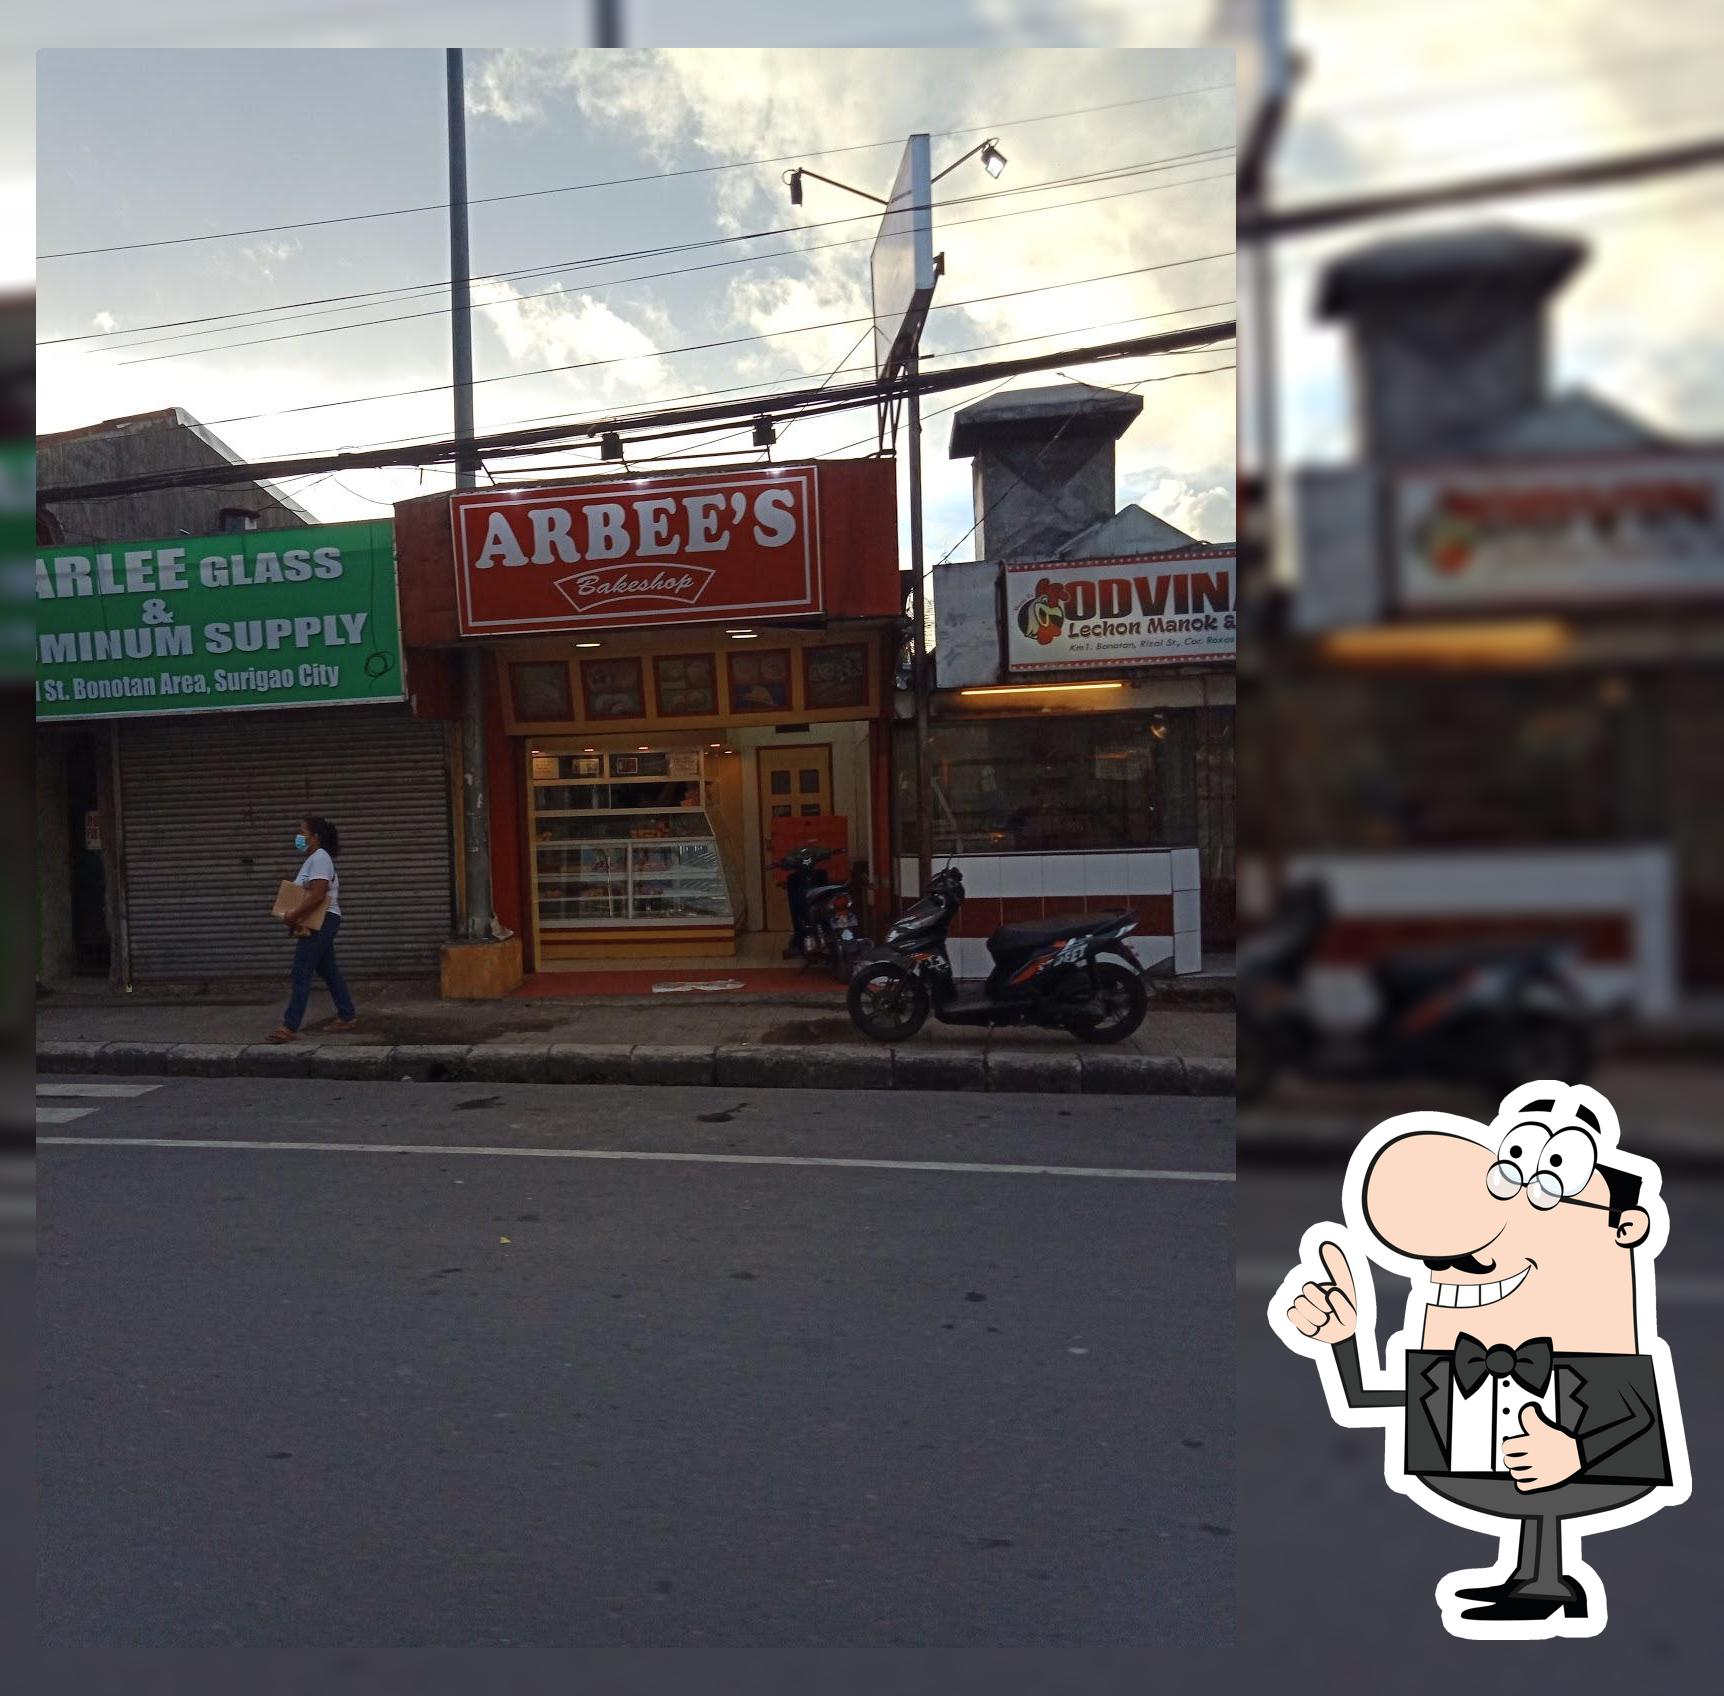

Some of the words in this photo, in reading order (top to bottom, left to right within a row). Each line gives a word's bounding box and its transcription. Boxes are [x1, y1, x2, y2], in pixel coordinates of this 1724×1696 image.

[475, 489, 797, 569] ARBEE'S
[199, 547, 343, 588] GLASS
[577, 572, 693, 597] Bakeshop
[142, 598, 174, 625] &
[1064, 571, 1237, 622] ODVIN
[36, 625, 193, 664] MINUM
[205, 612, 368, 654] SUPPLY
[1067, 622, 1141, 639] Lechon
[1148, 615, 1217, 634] Manok
[45, 679, 70, 702] St.
[74, 675, 156, 700] Bonotan
[160, 672, 211, 696] Area,
[215, 666, 294, 694] Surigao
[299, 662, 340, 689] City
